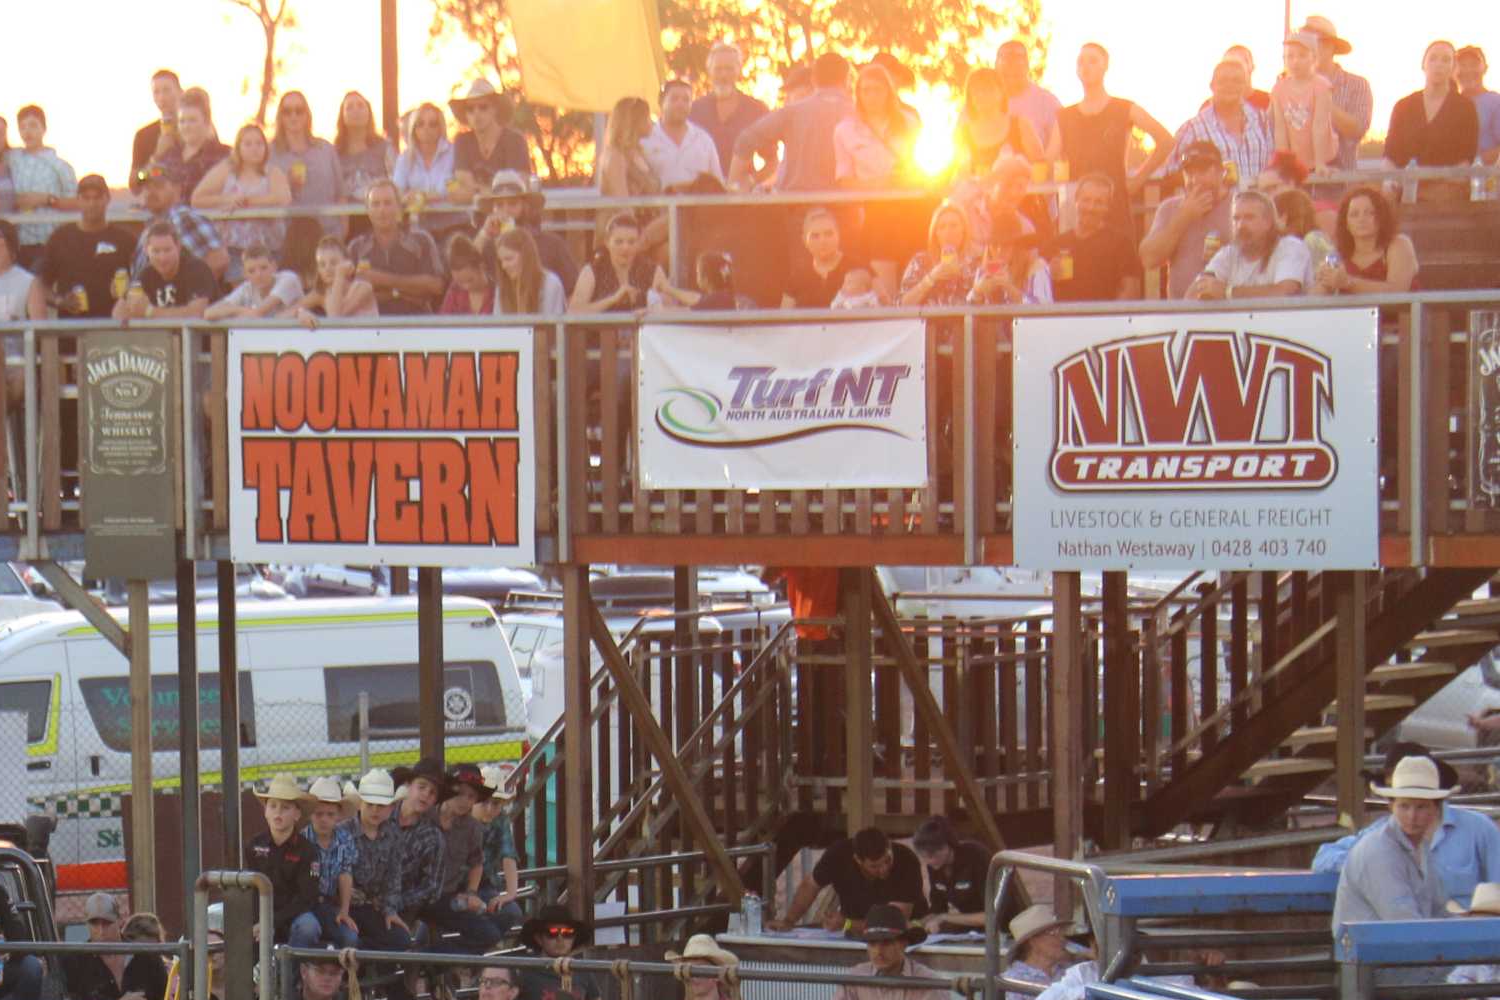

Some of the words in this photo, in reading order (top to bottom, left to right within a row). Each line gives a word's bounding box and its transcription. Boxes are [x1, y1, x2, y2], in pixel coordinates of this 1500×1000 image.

[241, 350, 520, 432] NOONAMAH
[1051, 330, 1336, 448] NWT
[726, 410, 766, 422] NORTH
[769, 408, 845, 421] AUSTRALIAN
[850, 406, 892, 418] LAWNS
[1073, 452, 1316, 482] TRANSPORT
[241, 435, 520, 546] TAVERN
[1050, 509, 1143, 529] LIVESTOCK
[1149, 510, 1162, 528] &
[1169, 508, 1251, 528] GENERAL
[1257, 508, 1333, 528] FREIGHT
[1057, 539, 1112, 557] Nathan
[1116, 538, 1196, 561] Westaway
[1211, 539, 1252, 557] 0428
[1258, 539, 1289, 557] 403
[1295, 538, 1327, 556] 740
